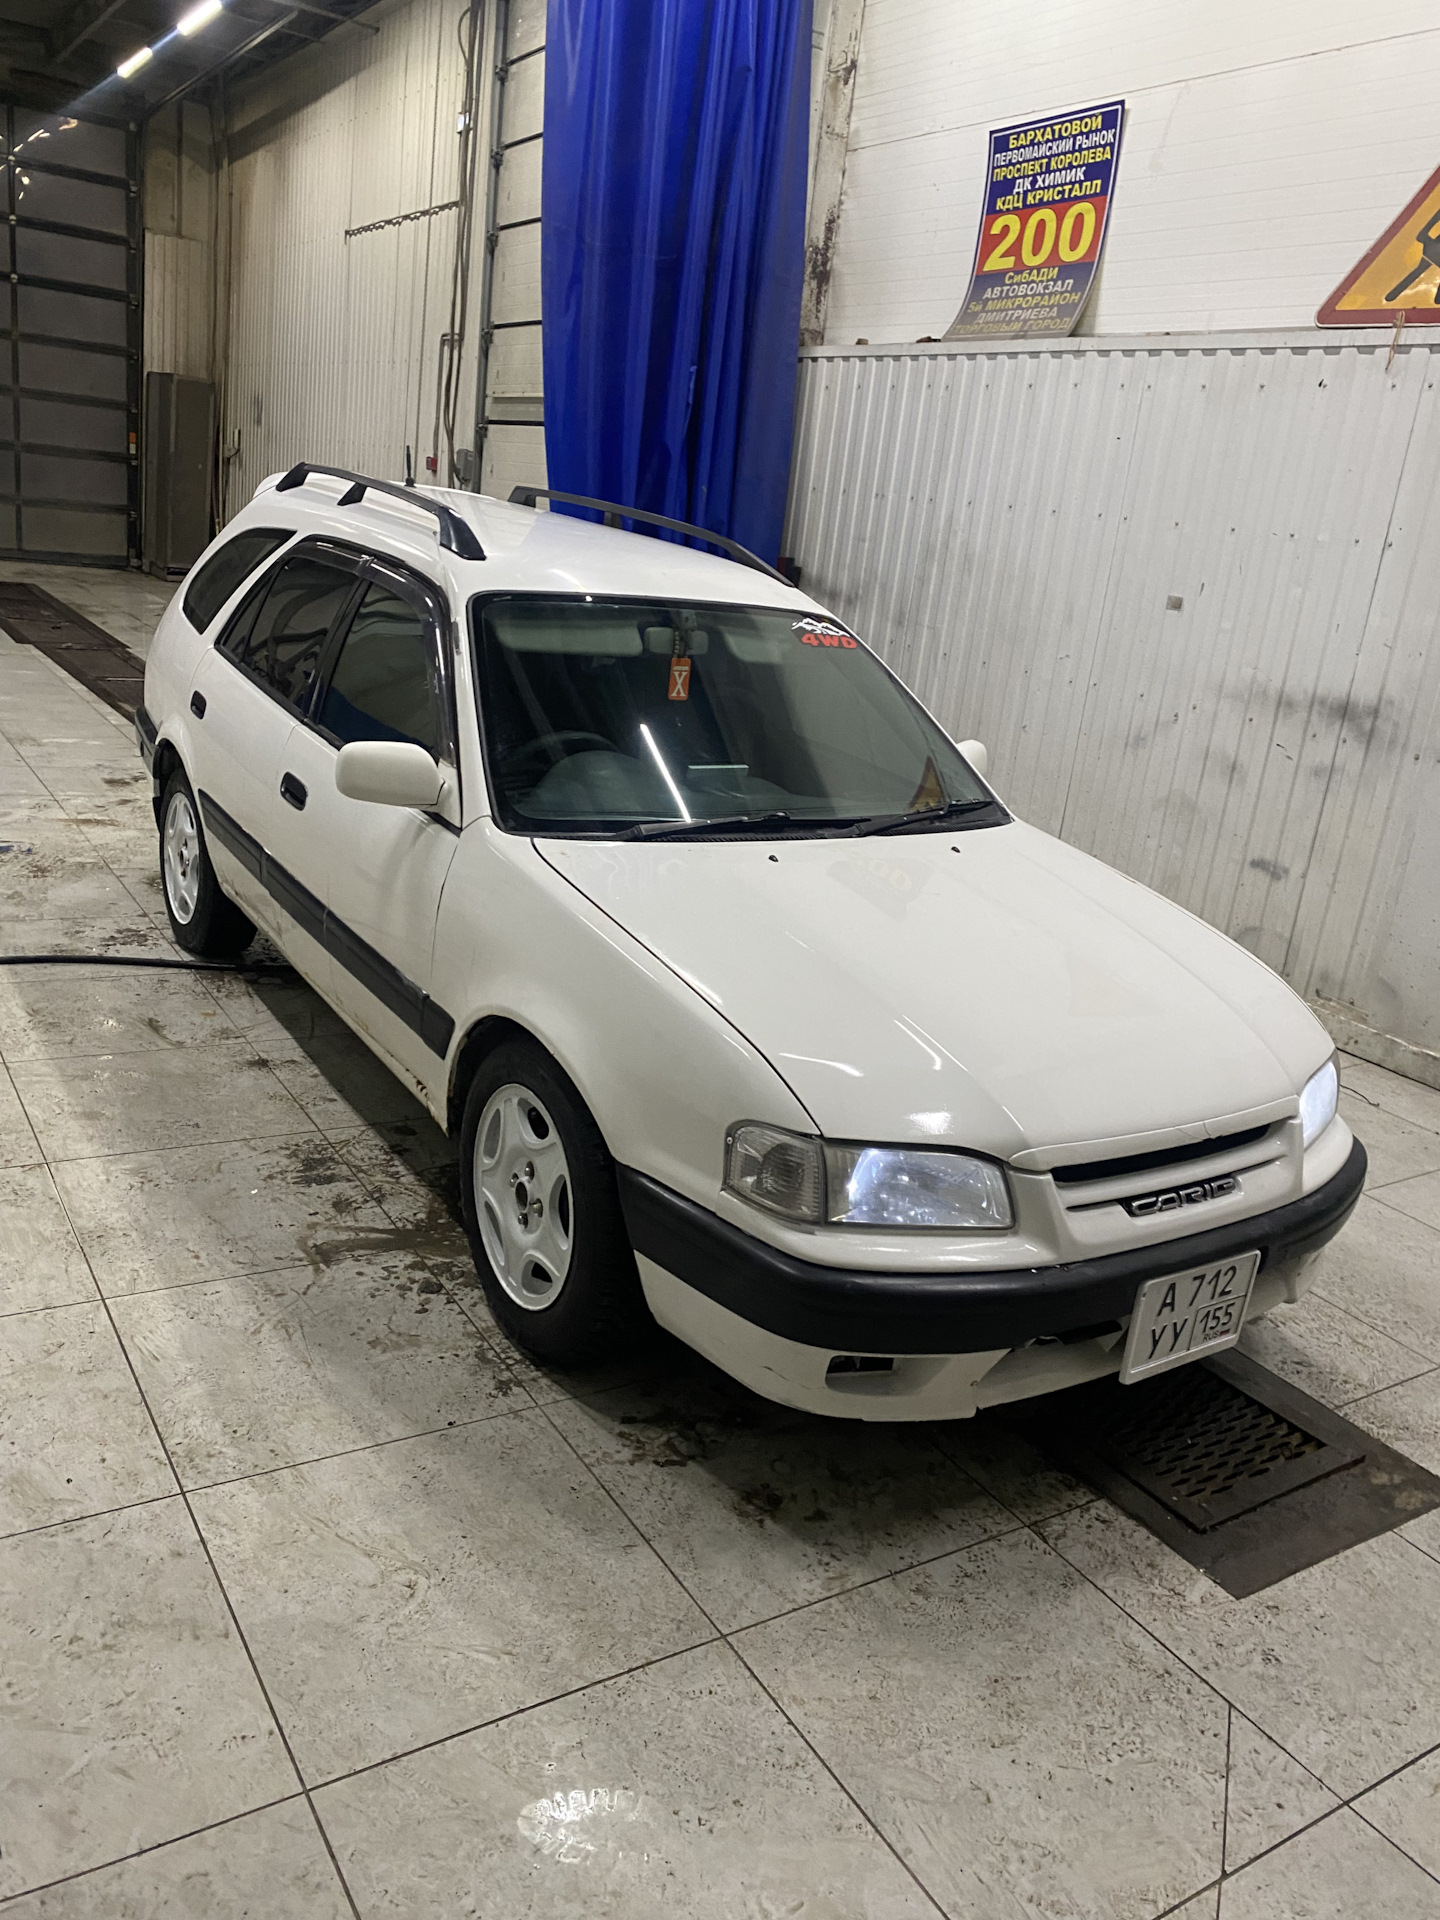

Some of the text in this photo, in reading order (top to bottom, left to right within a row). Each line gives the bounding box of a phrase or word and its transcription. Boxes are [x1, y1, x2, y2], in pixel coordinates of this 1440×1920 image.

[1009, 114, 1102, 148] БАРХАТОВОЙ
[994, 129, 1115, 166] ПЕРВОМАЙСКИЙ РЫНОК
[993, 146, 1111, 181] ПРОСПЕКТ КОРОЛЕВА
[1013, 167, 1085, 194] ДК ХИМИК
[996, 180, 1101, 210] КДЦ КРИСТАЛЛ
[983, 202, 1096, 272] 200
[1005, 267, 1058, 284] СибАДИ
[983, 279, 1074, 299] АВТОВОКЗАЛ
[984, 292, 1081, 311] МИКРОРАЙОН
[974, 307, 1058, 324] ДМИТРИЕВА
[1025, 317, 1072, 330] ГОРОД
[801, 633, 858, 649] 4WD
[671, 672, 688, 697] X
[1189, 1265, 1238, 1307] 712
[1199, 1302, 1236, 1334] 155
[1203, 1330, 1220, 1342] RUS
